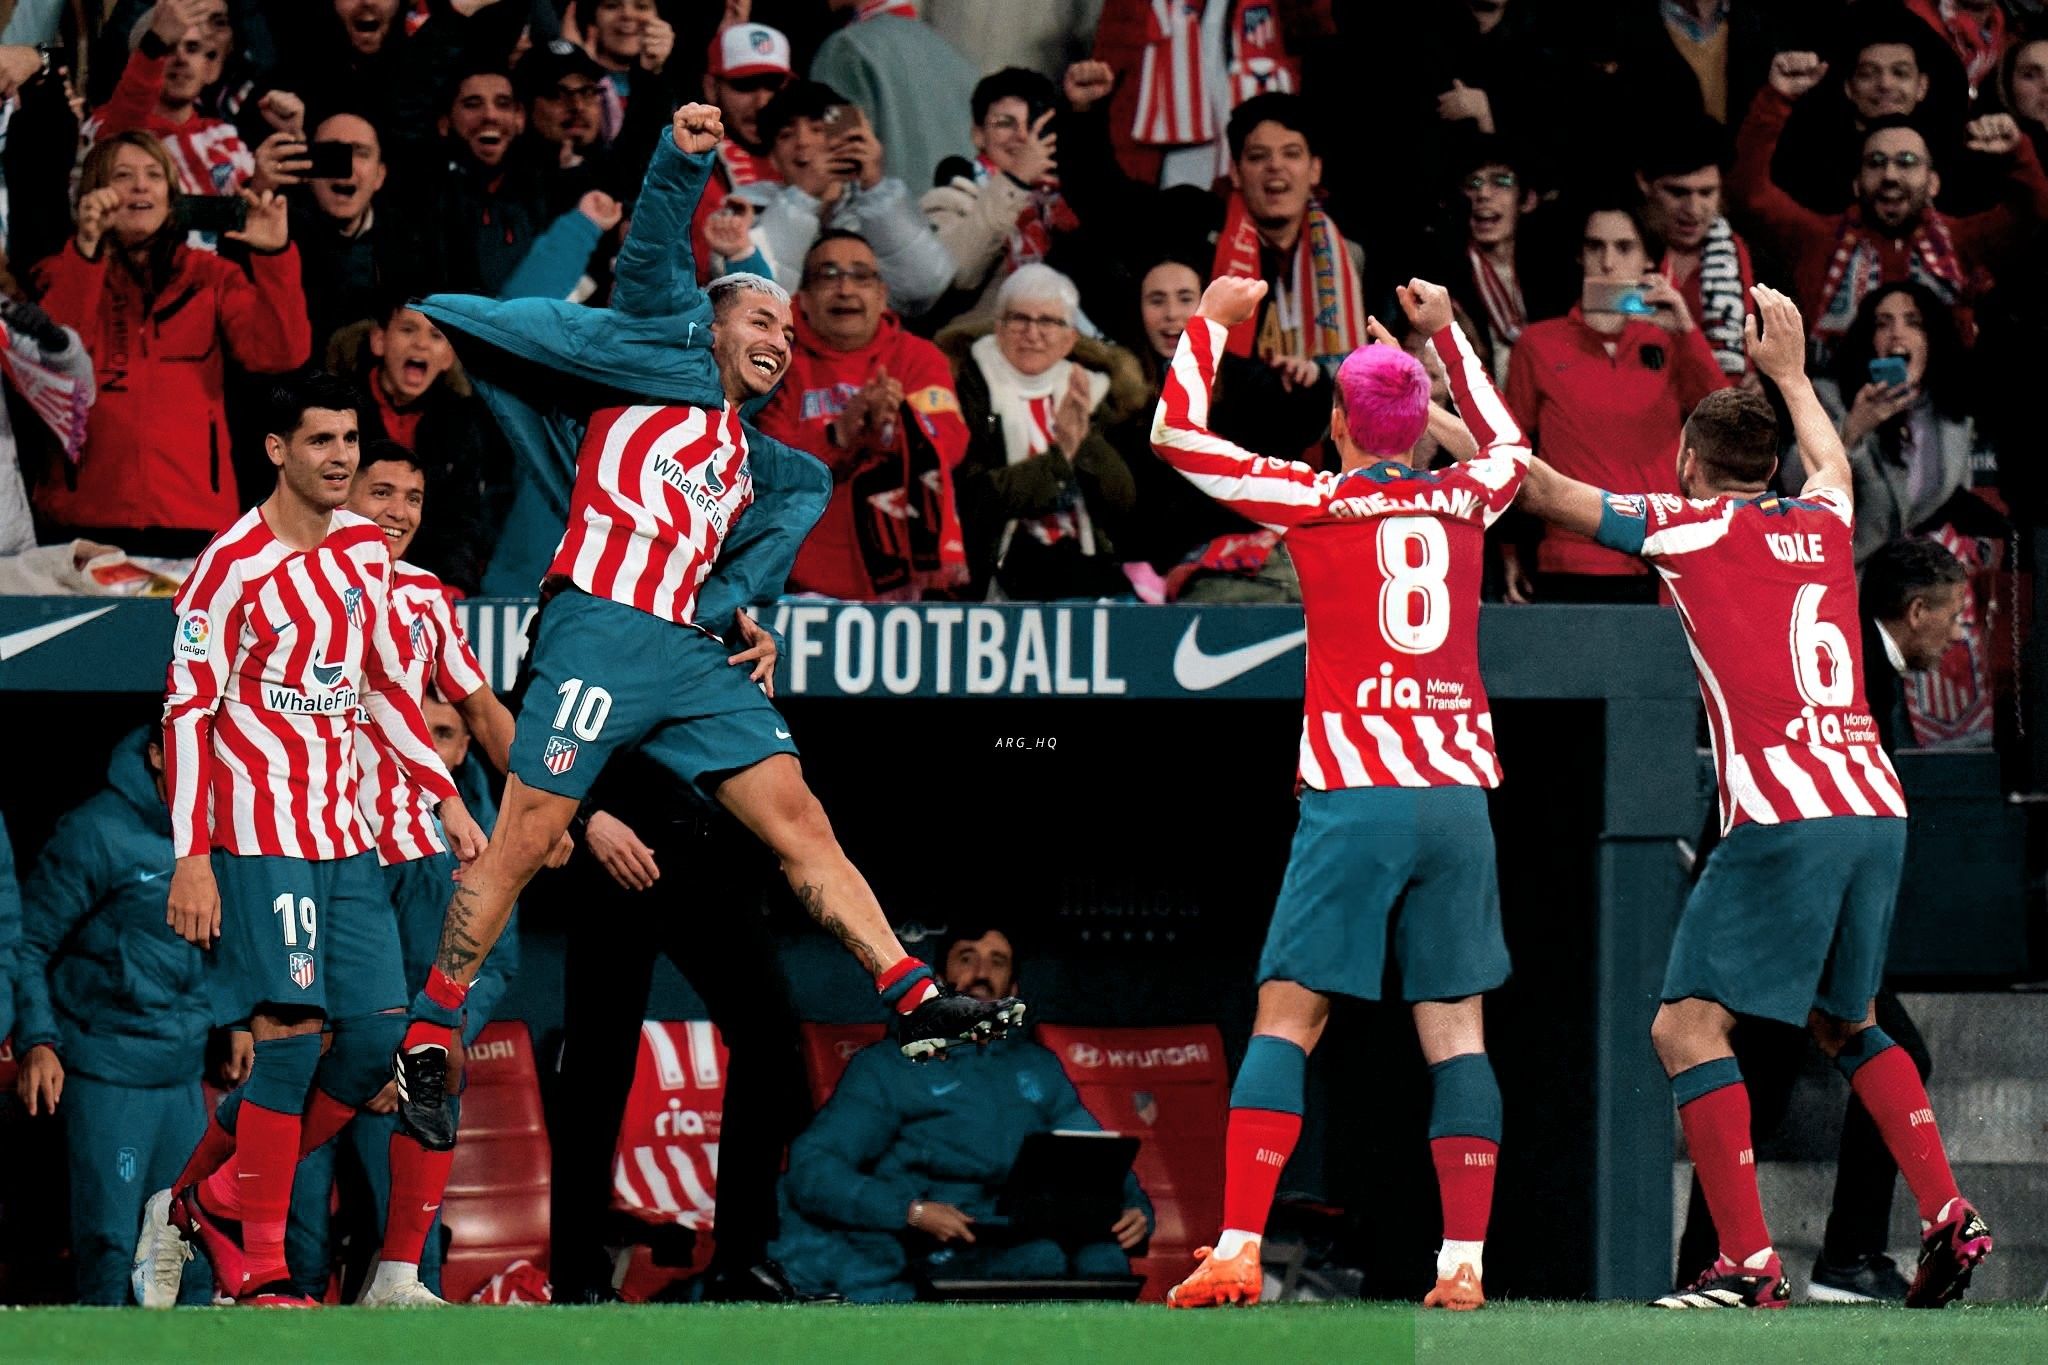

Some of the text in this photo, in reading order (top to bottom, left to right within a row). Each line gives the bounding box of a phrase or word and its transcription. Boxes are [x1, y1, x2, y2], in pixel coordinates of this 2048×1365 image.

[653, 454, 723, 531] WhaleFin
[1765, 533, 1825, 562] KOKE
[1376, 515, 1450, 655] 8
[179, 643, 206, 656] LaLiga
[1789, 583, 1854, 707] 6
[269, 690, 357, 713] WhaleFin
[1356, 661, 1421, 708] ria
[1425, 697, 1472, 710] Transfer
[1427, 678, 1464, 698] Money
[552, 678, 613, 742] 10
[1785, 705, 1844, 745] ria
[1843, 713, 1873, 731] Money
[273, 893, 317, 950] 19
[1107, 1043, 1210, 1068] HYUNDAI
[654, 1097, 706, 1137] ria
